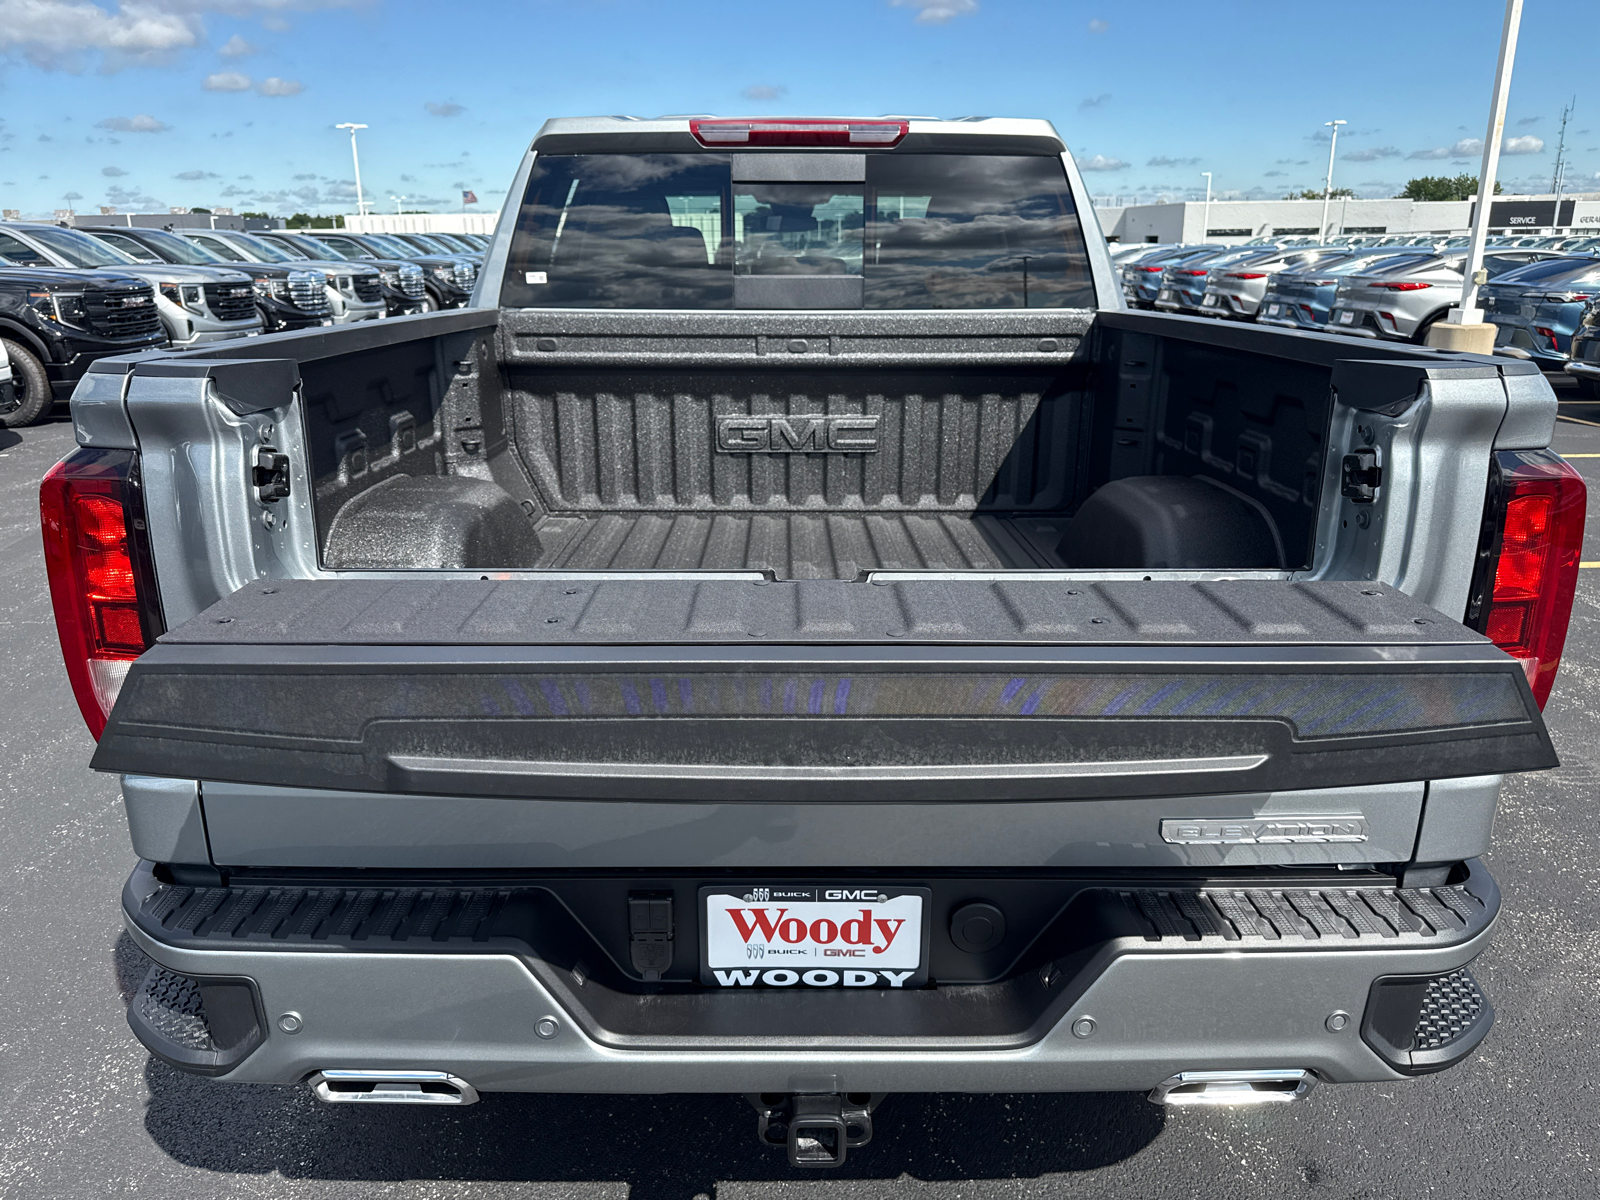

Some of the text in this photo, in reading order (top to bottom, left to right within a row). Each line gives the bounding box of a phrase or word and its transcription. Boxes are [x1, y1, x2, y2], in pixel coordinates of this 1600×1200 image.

[1509, 216, 1536, 224] SERVICE
[718, 418, 878, 450] GMC
[1177, 822, 1356, 838] ELEVATION
[825, 890, 878, 900] GMC
[725, 908, 906, 954] Woody
[823, 948, 866, 957] GMC
[713, 969, 915, 987] WOODY
